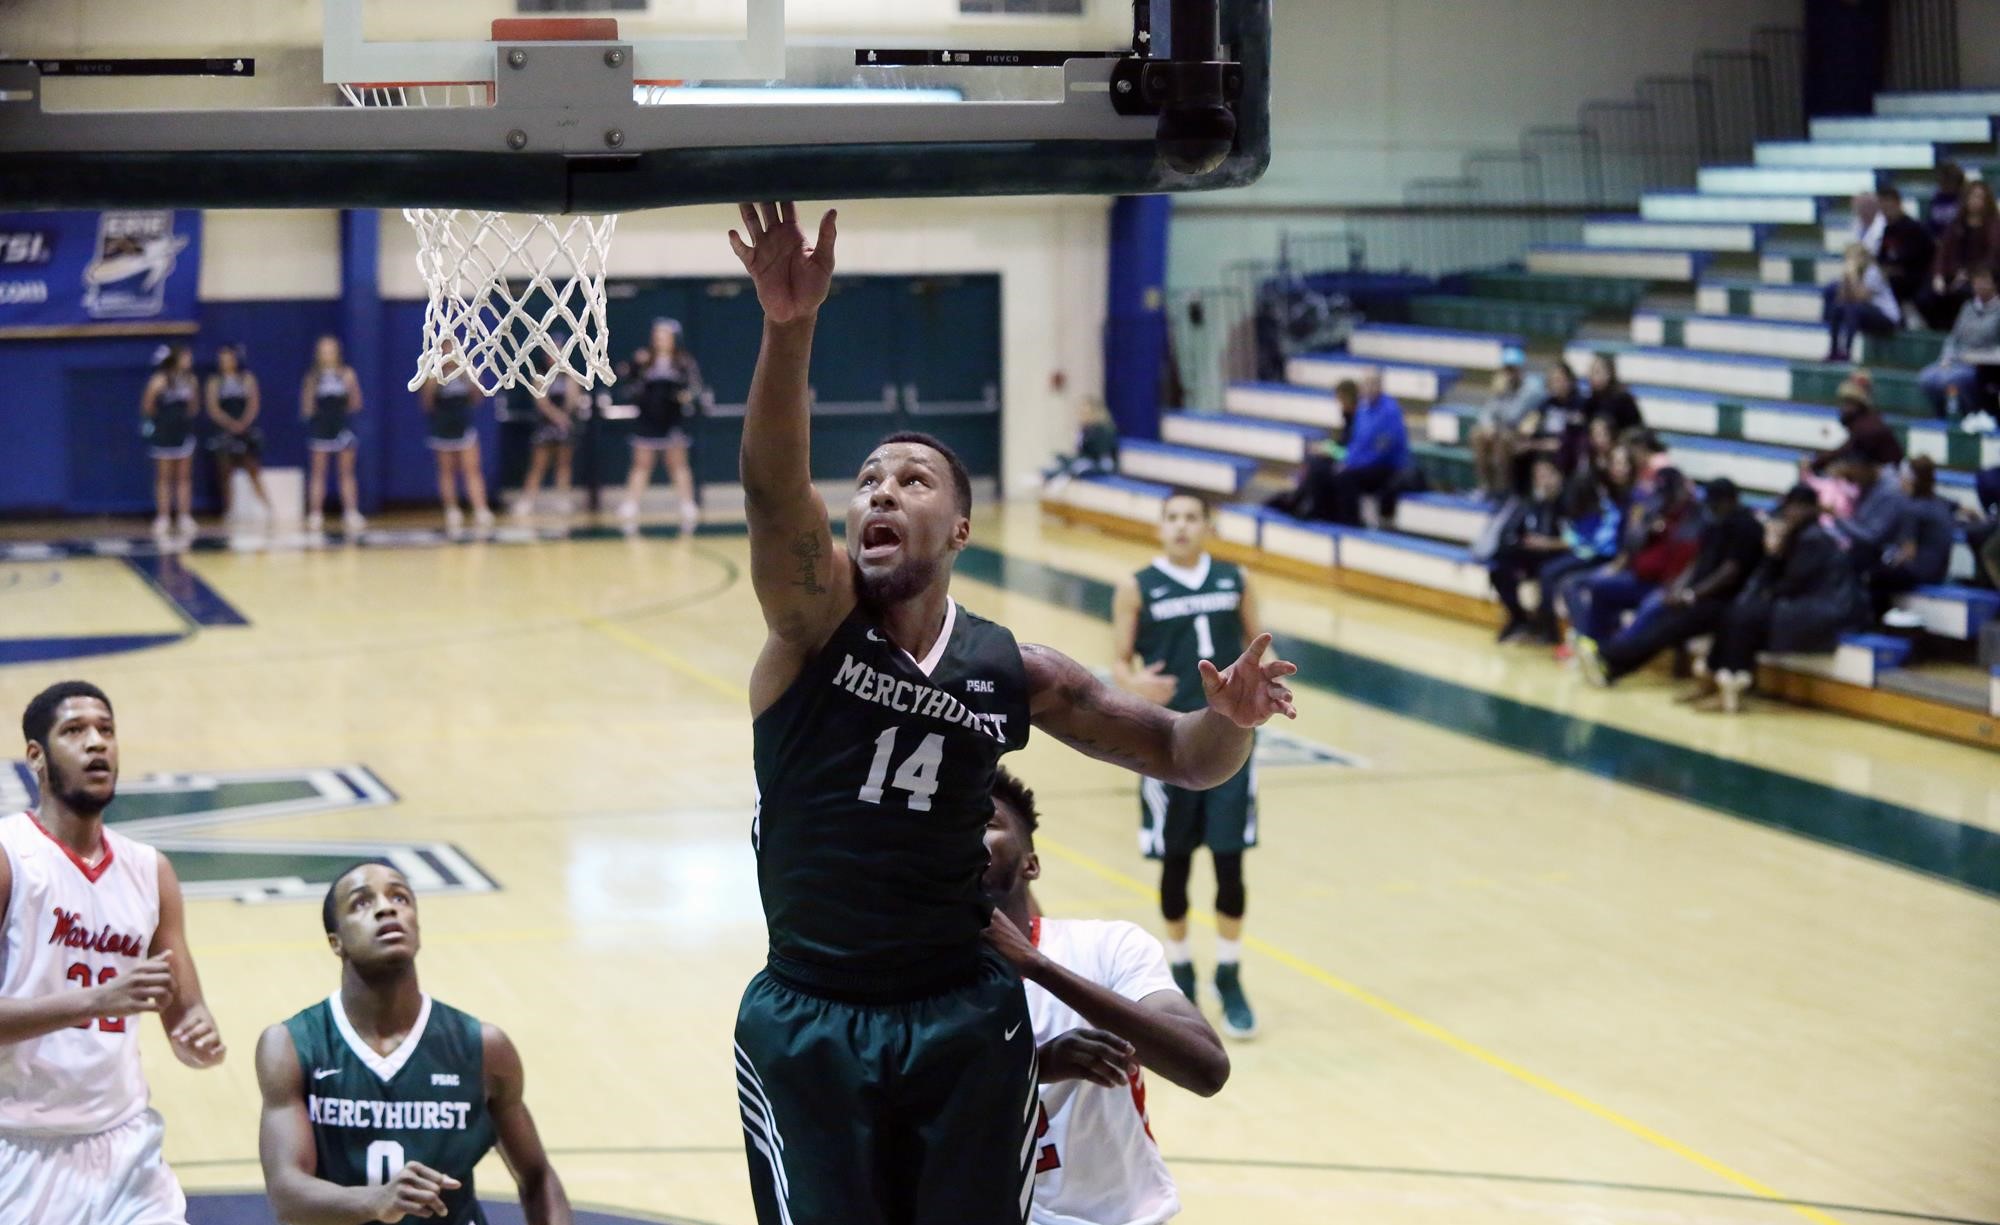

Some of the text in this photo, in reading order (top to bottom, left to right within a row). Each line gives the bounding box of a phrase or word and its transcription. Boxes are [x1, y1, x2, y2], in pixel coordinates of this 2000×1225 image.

[1194, 613, 1215, 658] 1
[966, 679, 995, 693] PSAC
[857, 726, 946, 812] 14
[308, 1094, 472, 1130] MERCYHURST
